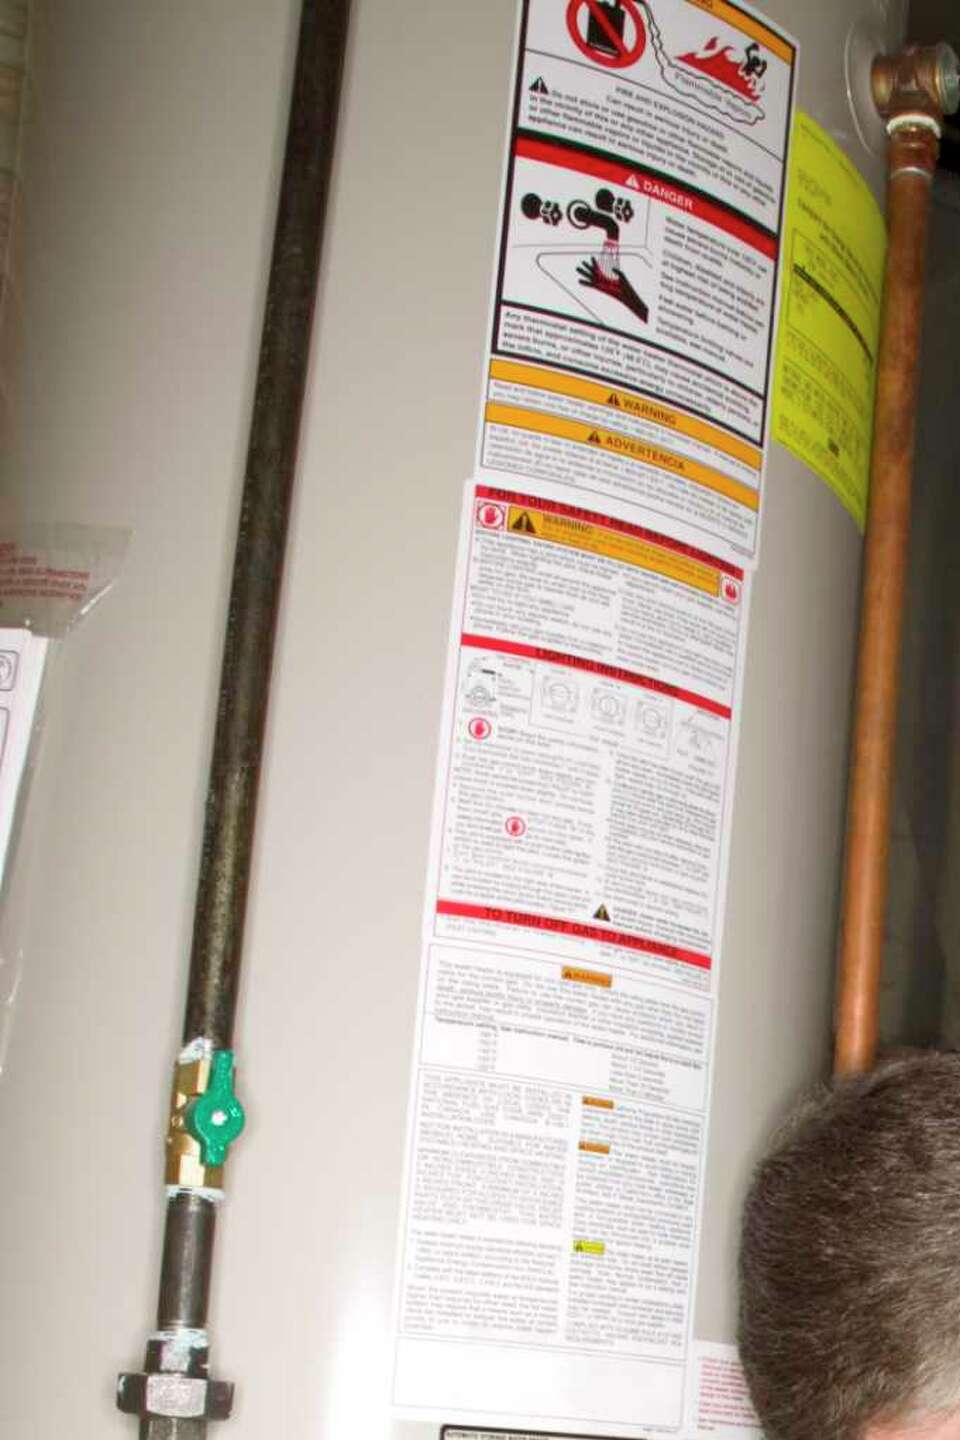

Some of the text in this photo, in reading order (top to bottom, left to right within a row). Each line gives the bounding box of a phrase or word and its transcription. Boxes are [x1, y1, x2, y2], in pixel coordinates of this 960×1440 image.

[643, 180, 694, 210] DANGER
[624, 398, 676, 425] WARNING
[606, 436, 685, 470] ADVERTENCIA
